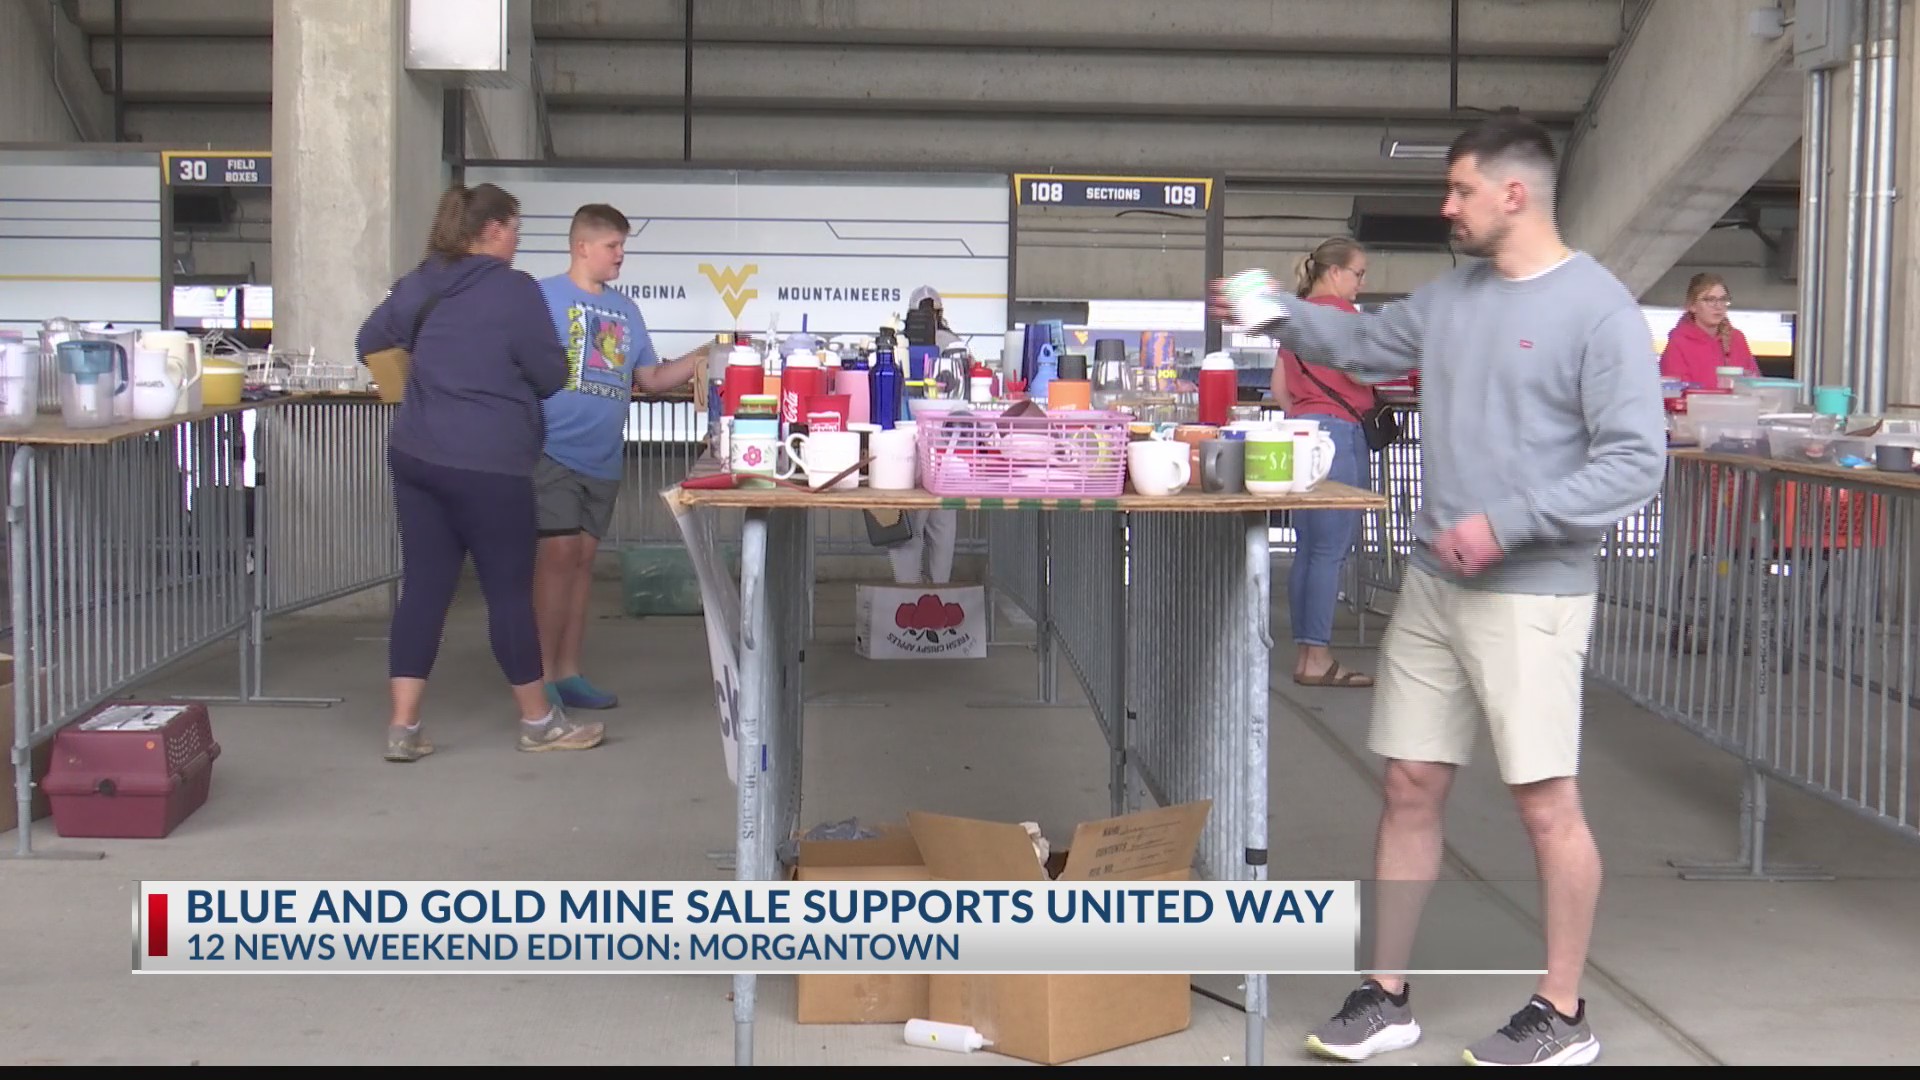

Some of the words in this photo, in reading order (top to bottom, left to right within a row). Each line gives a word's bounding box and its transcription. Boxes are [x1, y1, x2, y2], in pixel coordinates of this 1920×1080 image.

[180, 160, 207, 180] 30
[227, 159, 256, 170] FIELD
[225, 171, 258, 182] BOXES
[1031, 182, 1063, 202] 108
[1086, 187, 1141, 201] SECTIONS
[1164, 185, 1196, 205] 109
[778, 286, 901, 302] MOUNTAINEERS
[887, 632, 915, 652] APPLES
[916, 643, 945, 655] CRISPY
[946, 632, 970, 651] FRESH
